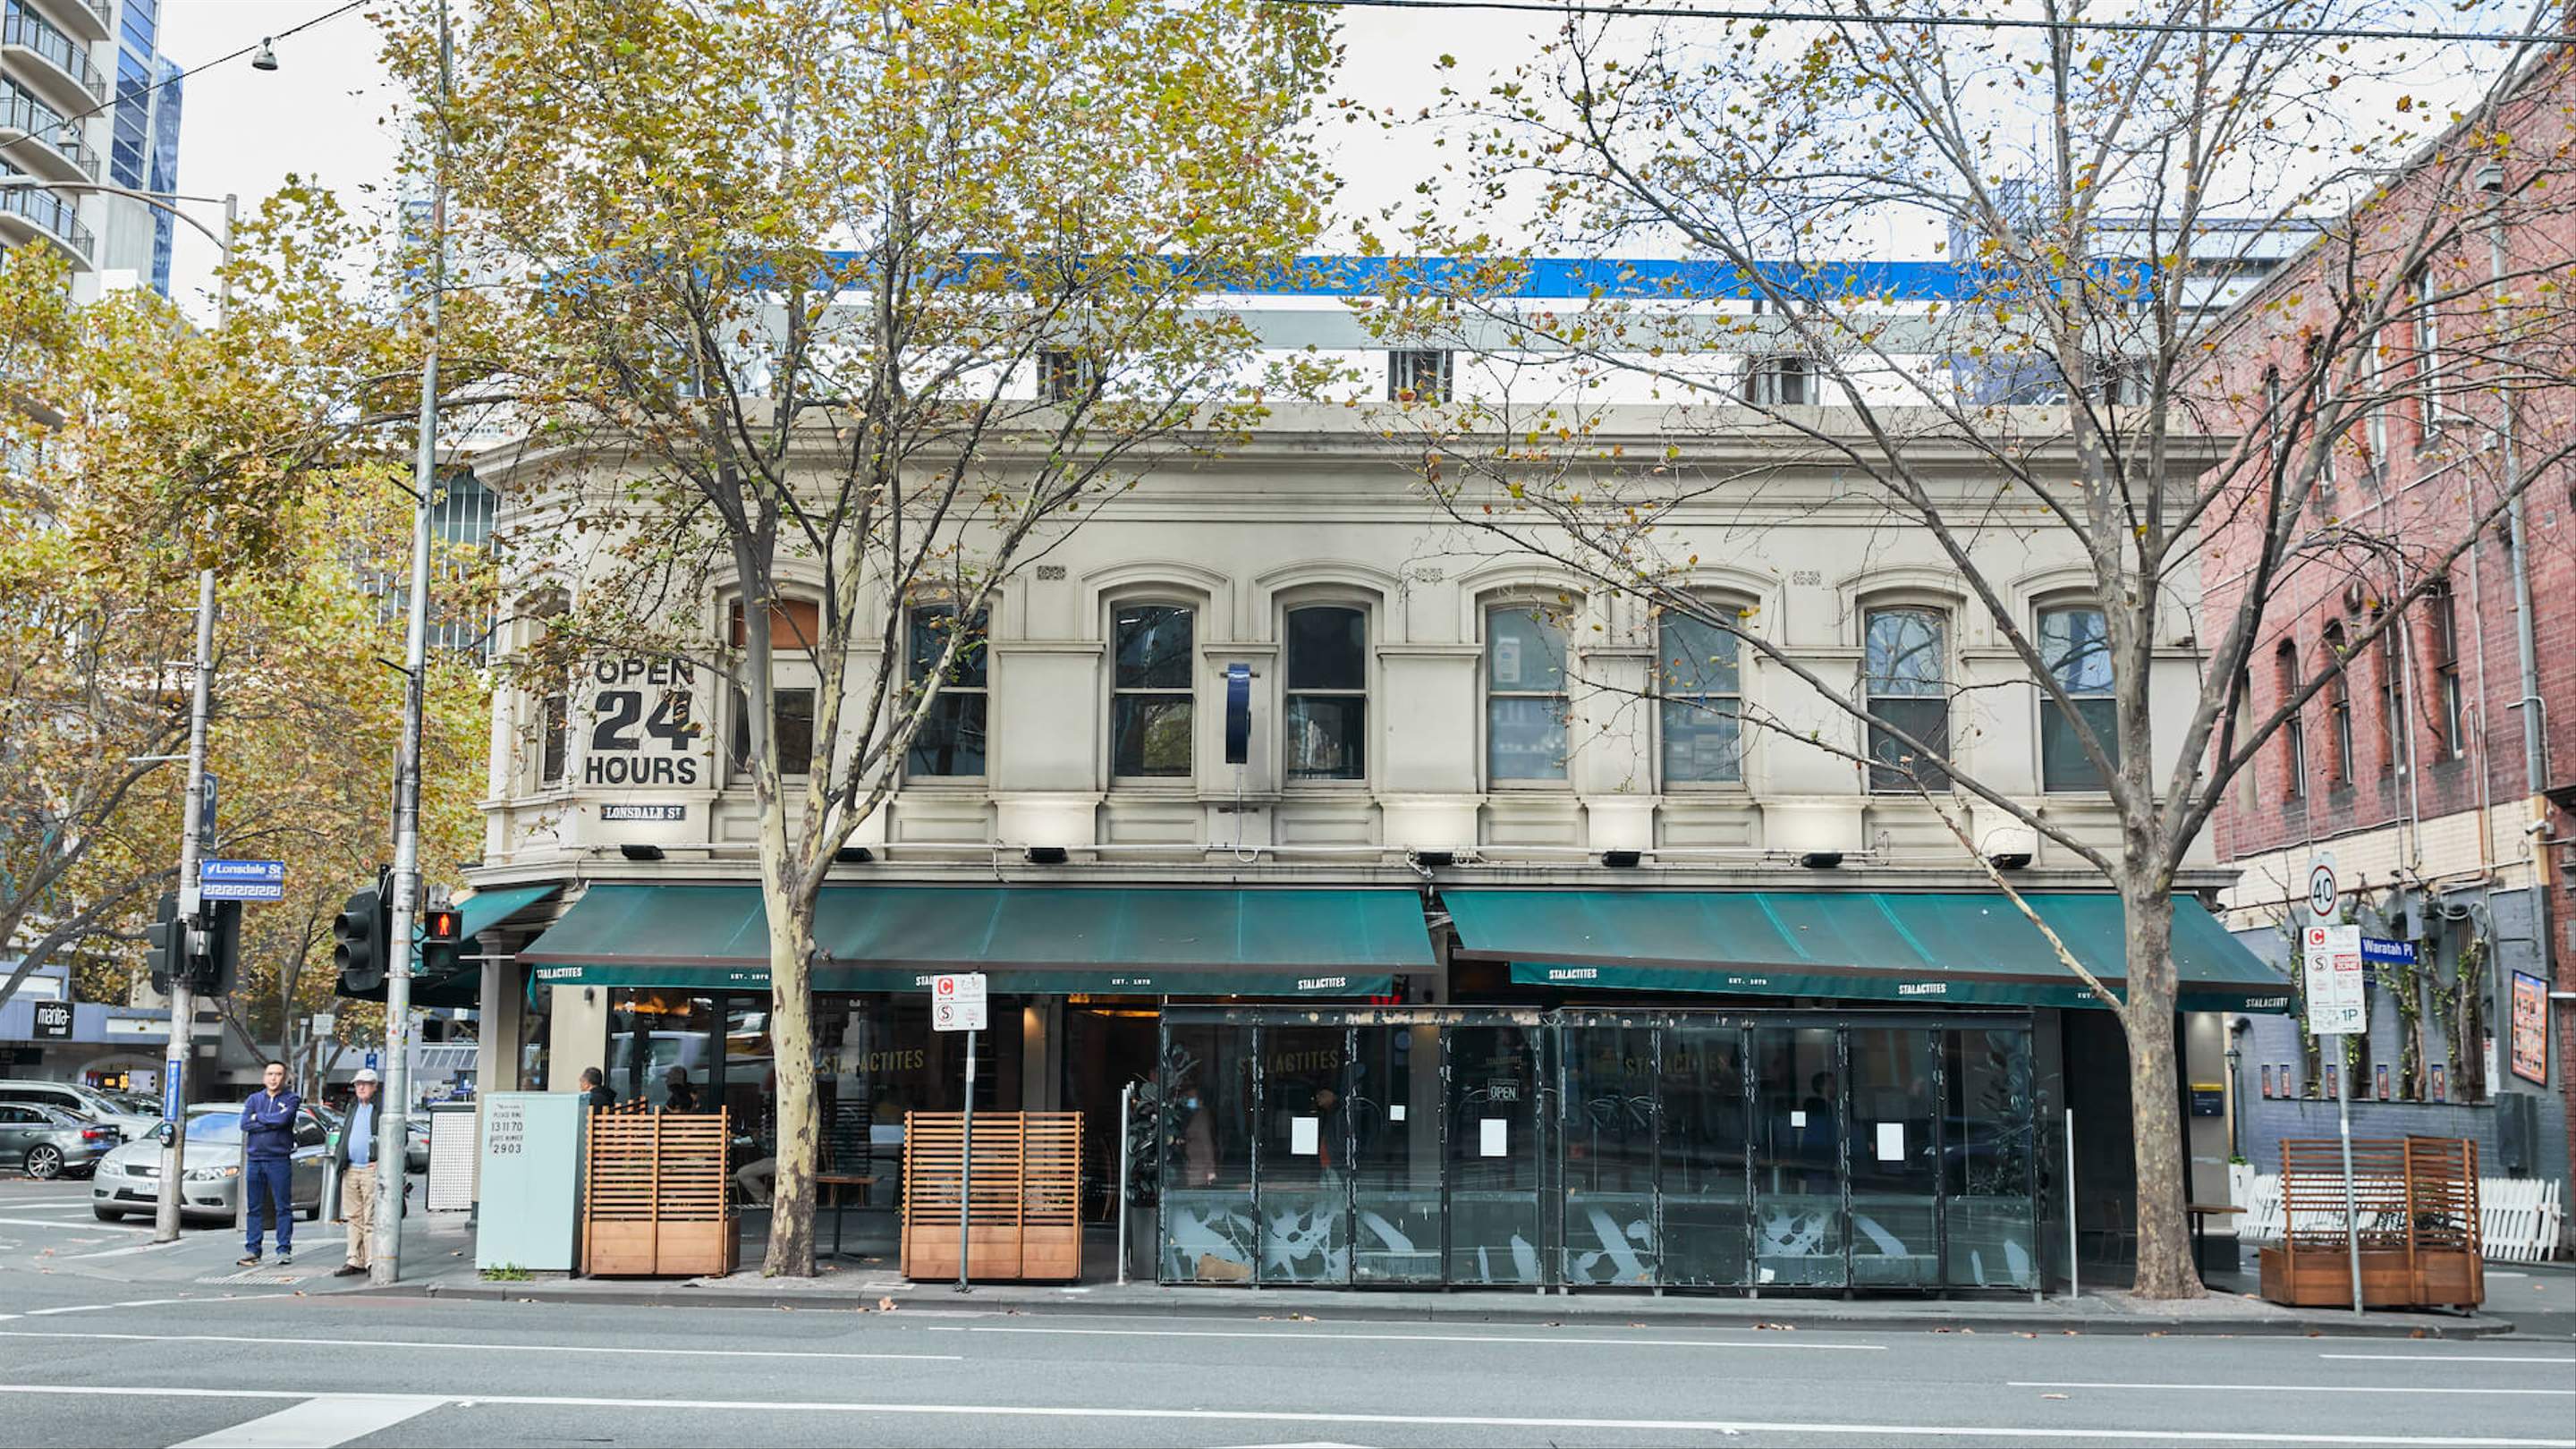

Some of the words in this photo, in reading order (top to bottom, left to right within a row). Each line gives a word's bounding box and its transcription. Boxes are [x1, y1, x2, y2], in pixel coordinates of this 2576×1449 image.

[595, 657, 695, 685] OPEN
[592, 691, 700, 750] 24
[585, 757, 697, 784] HOURS
[606, 807, 665, 819] LONSDALE
[216, 862, 266, 874] Lonsdale
[268, 863, 282, 874] St
[2313, 877, 2333, 903] 40
[2362, 939, 2402, 956] Waratah
[2403, 944, 2413, 957] Pl
[1549, 968, 1597, 980] STALACTITES
[1298, 977, 1346, 990] STALACTITES
[1899, 983, 1946, 995] STALACTITES
[2245, 997, 2288, 1008] STALACTIT
[38, 1007, 71, 1026] mantra
[2342, 1008, 2358, 1021] 1P
[822, 1049, 924, 1074] STACTITES
[1238, 1050, 1339, 1074] STLACTITES
[1490, 1086, 1516, 1099] OPEN
[494, 1143, 521, 1154] 2903
